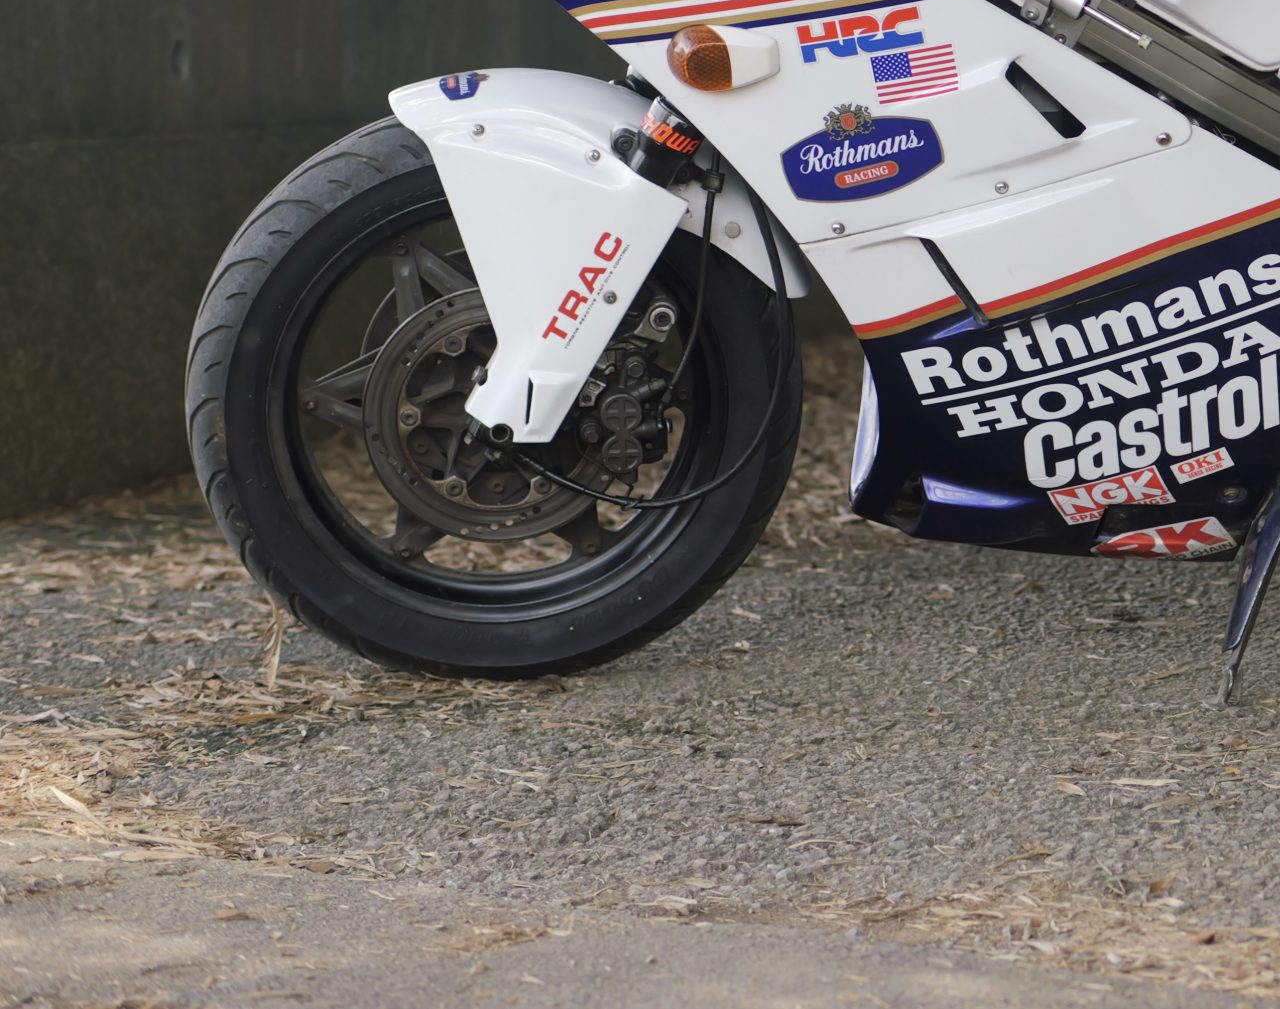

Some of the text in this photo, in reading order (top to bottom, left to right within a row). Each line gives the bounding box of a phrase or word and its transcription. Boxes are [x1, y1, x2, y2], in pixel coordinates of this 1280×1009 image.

[796, 6, 925, 63] HRC
[800, 130, 924, 174] Rothmans
[843, 166, 889, 184] RACING
[542, 232, 622, 339] TRAC
[1023, 354, 1280, 489] Castrol
[1177, 451, 1224, 474] OKI
[1053, 469, 1162, 517] NGK
[1069, 511, 1103, 523] SPA
[1191, 541, 1234, 557] CHAIN
